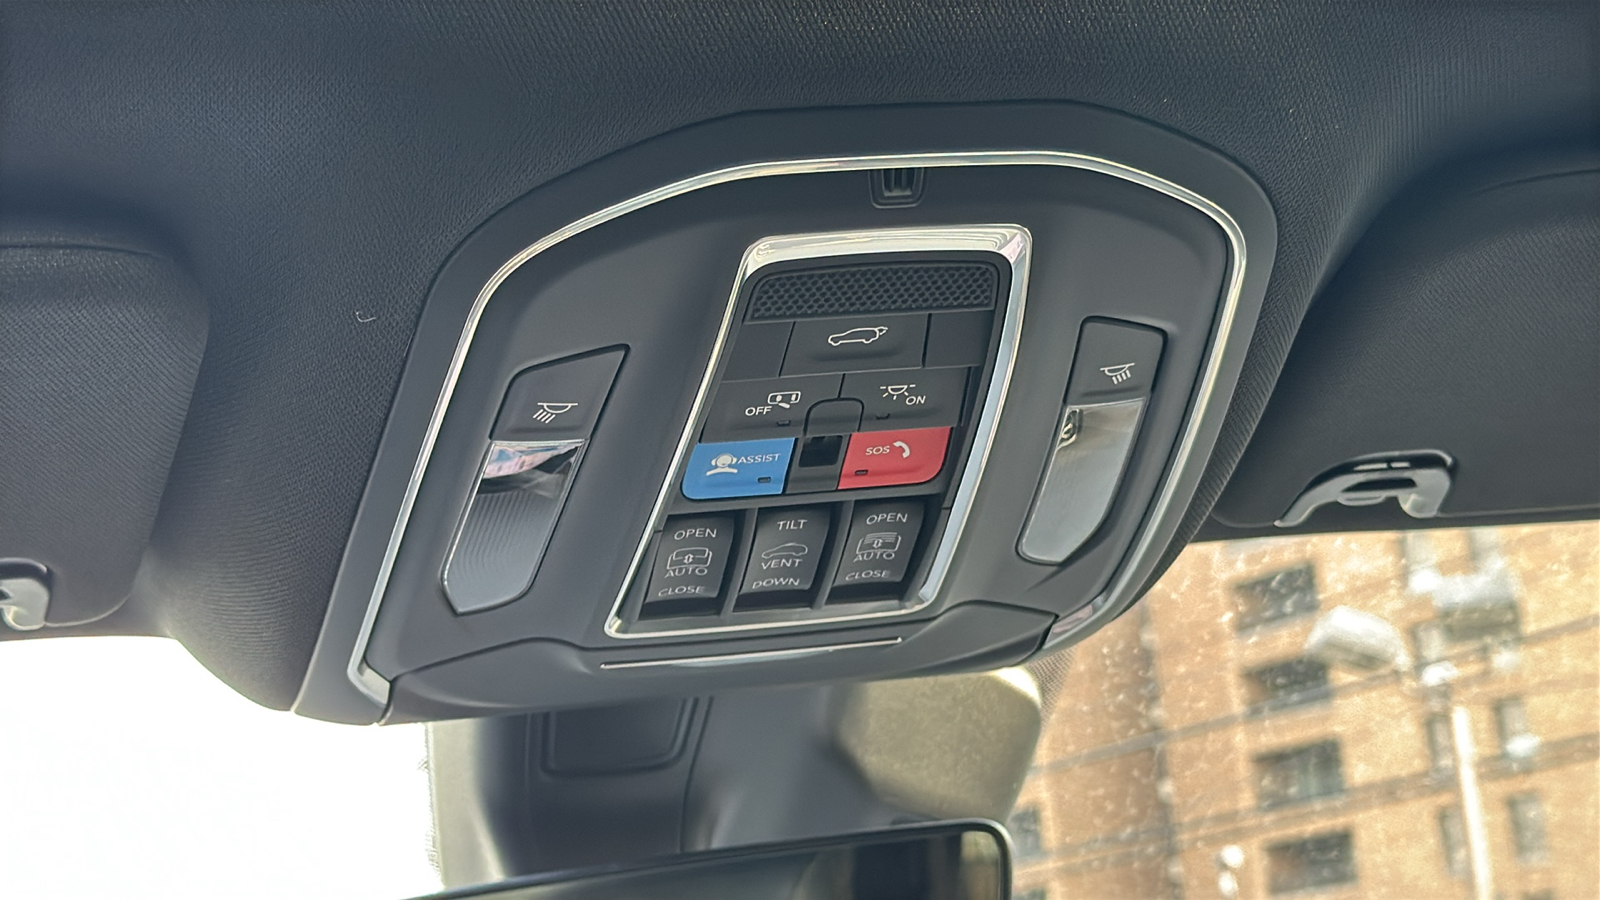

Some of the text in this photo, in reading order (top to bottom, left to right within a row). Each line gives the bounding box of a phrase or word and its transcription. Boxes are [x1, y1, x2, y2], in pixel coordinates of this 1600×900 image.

[905, 395, 926, 406] ON
[744, 405, 772, 417] OFF
[865, 445, 890, 456] SOS
[737, 453, 781, 465] ASSIST
[777, 518, 808, 531] TILT
[866, 512, 908, 525] OPEN
[673, 527, 717, 541] OPEN
[853, 551, 895, 563] AUTO
[761, 558, 803, 570] VENT
[664, 566, 708, 578] AUTO
[845, 570, 891, 581] CLOSE
[752, 577, 800, 589] DOWN
[658, 585, 706, 597] CLOSE
